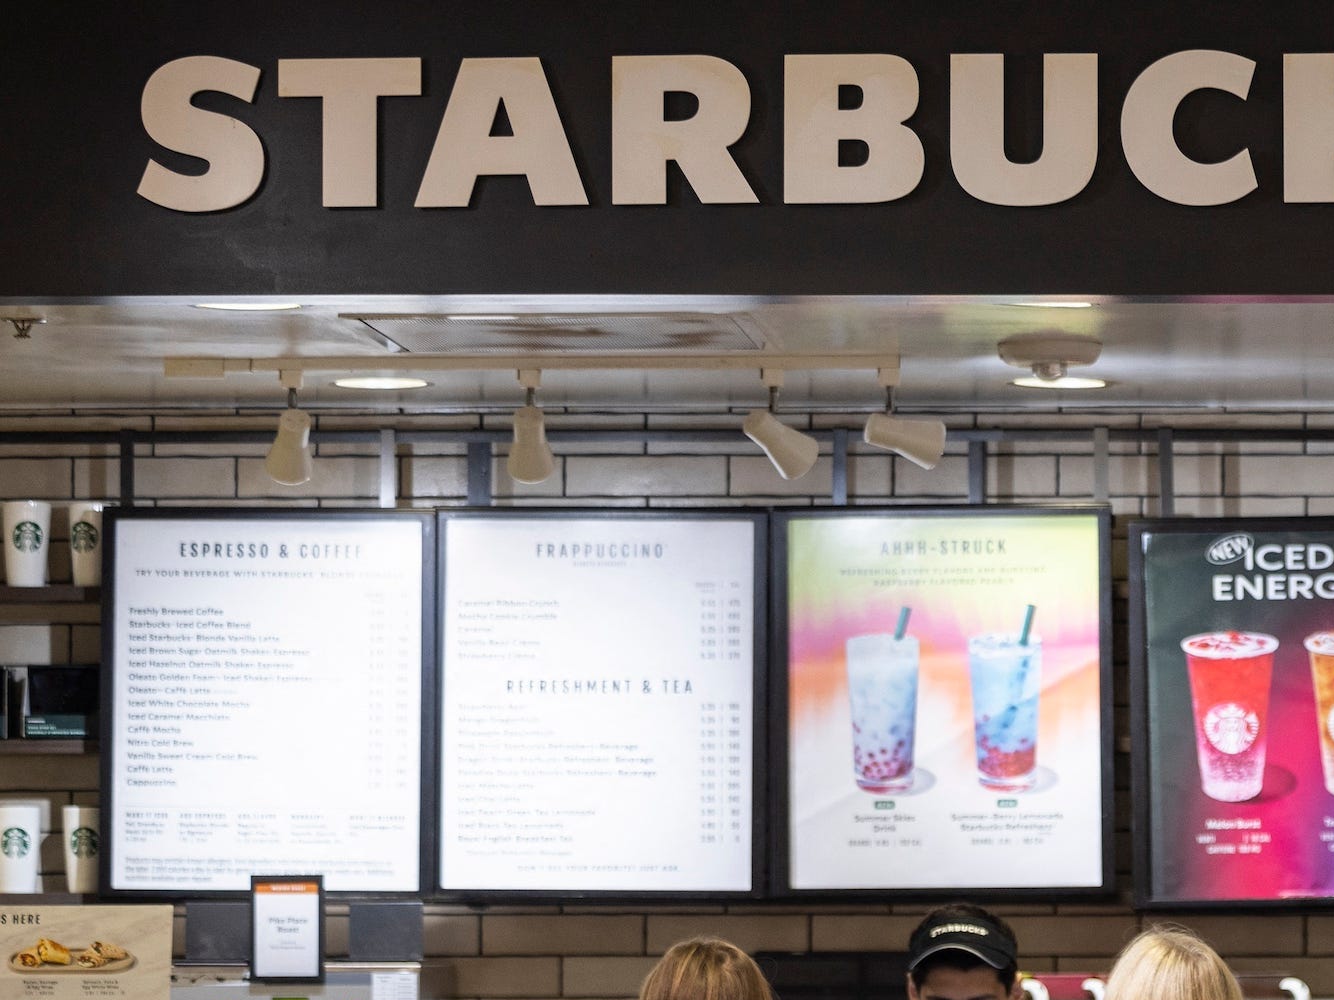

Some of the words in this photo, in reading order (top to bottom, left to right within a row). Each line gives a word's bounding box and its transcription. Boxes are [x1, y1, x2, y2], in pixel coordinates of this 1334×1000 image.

[180, 543, 269, 558] ESPRESSO
[280, 543, 289, 558] &
[536, 543, 664, 558] FRAPPUCCINO
[1210, 536, 1250, 562] NEW
[1244, 543, 1334, 571] ICED
[155, 569, 180, 578] YOUR
[507, 679, 632, 694] REFRESHMENT
[641, 679, 652, 694] &
[662, 679, 693, 694] TEA
[13, 914, 41, 925] HERE
[930, 924, 988, 938] STARBUCKS
